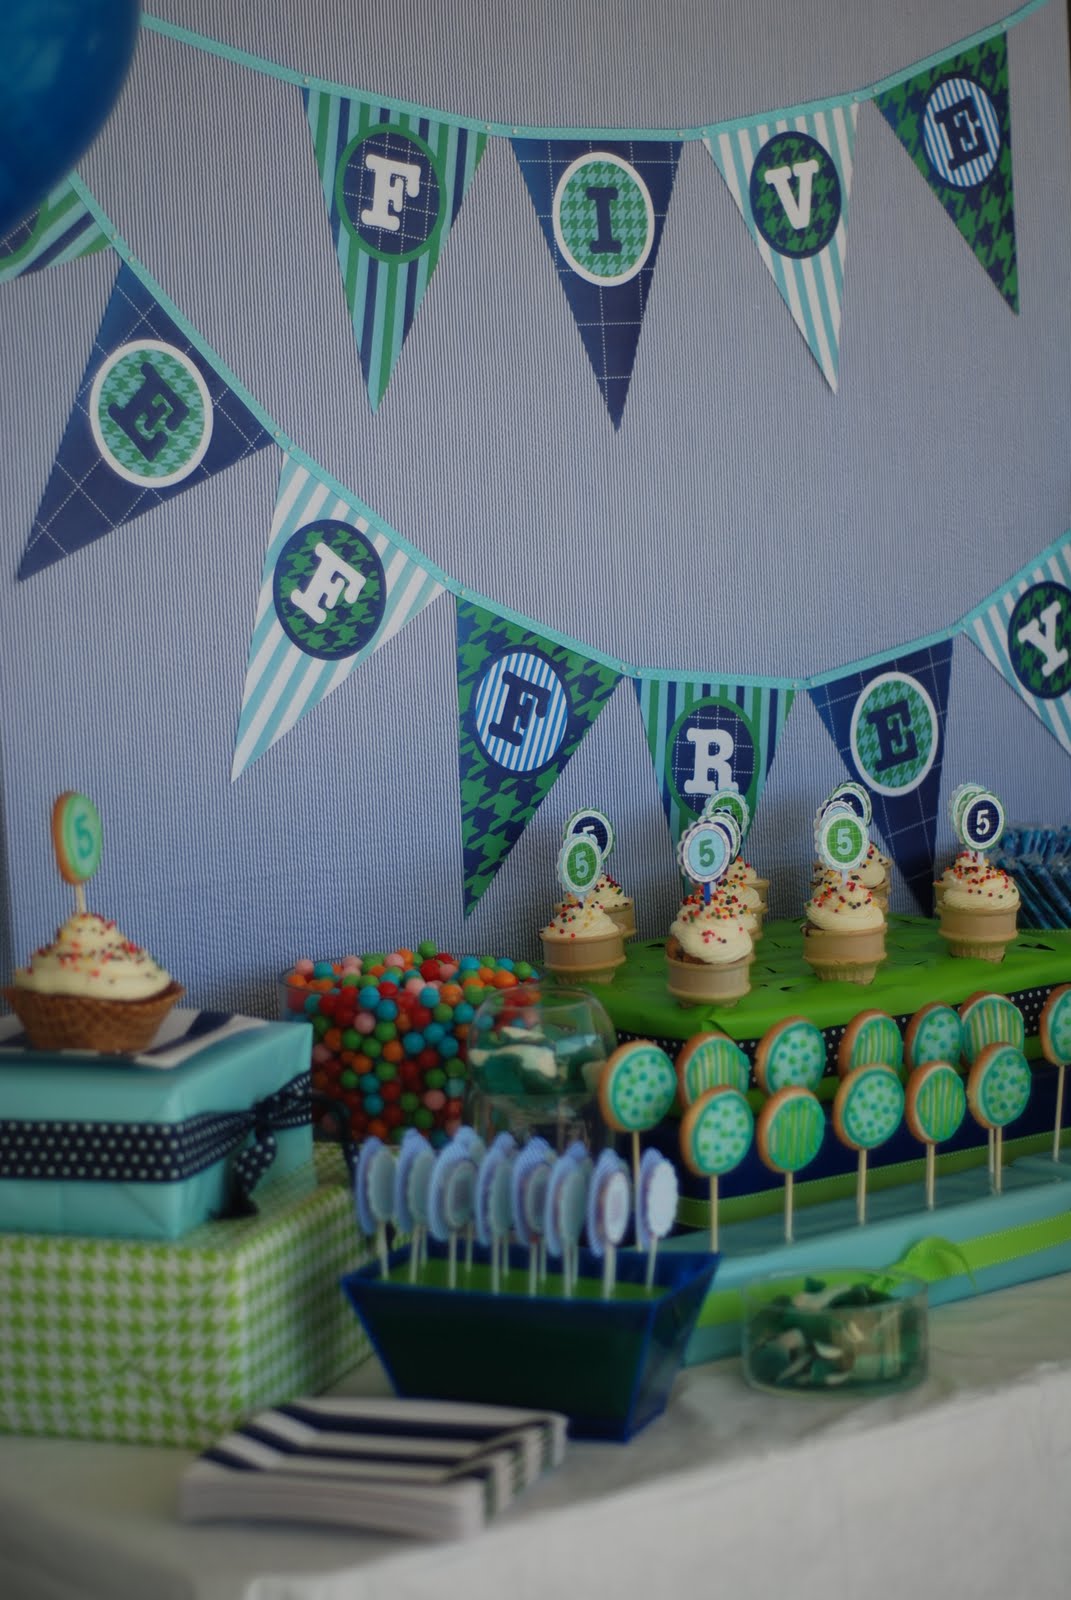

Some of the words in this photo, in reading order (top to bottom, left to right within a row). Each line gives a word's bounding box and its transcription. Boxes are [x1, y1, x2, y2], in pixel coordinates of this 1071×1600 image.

[362, 153, 422, 231] F
[586, 186, 623, 254] I
[765, 159, 820, 231] V
[936, 96, 983, 172] E
[107, 361, 191, 463] E
[289, 541, 367, 625] F
[487, 670, 552, 747] F
[683, 727, 740, 794] R
[865, 698, 919, 772] E
[1017, 600, 1070, 679] Y
[74, 812, 94, 860] 5
[975, 809, 990, 836] 5
[698, 838, 716, 868] 5
[837, 827, 853, 856] 5
[575, 850, 589, 879] 5
